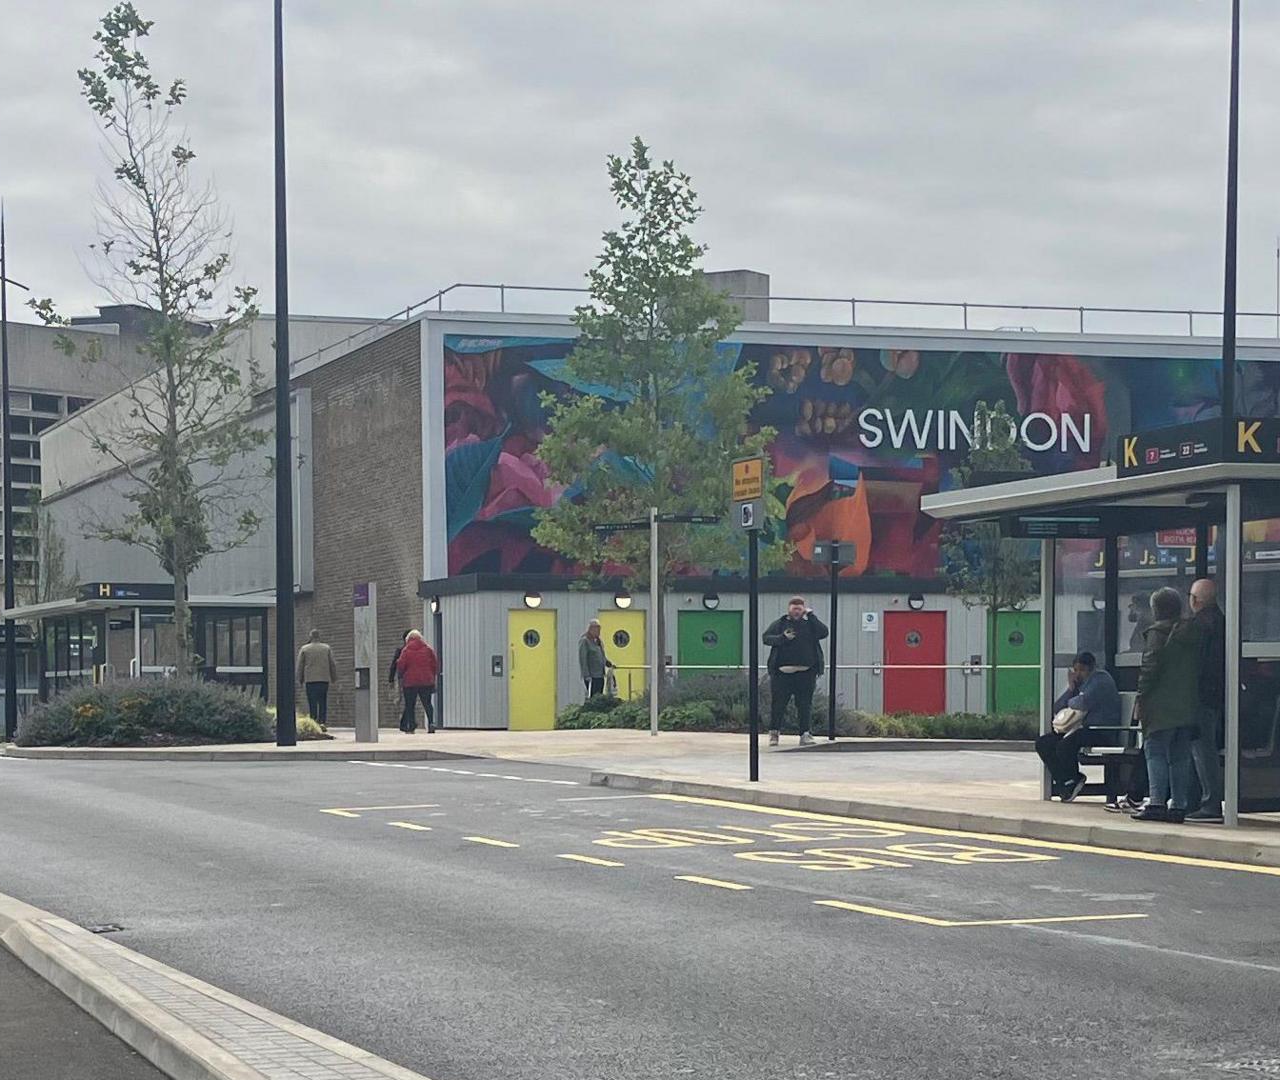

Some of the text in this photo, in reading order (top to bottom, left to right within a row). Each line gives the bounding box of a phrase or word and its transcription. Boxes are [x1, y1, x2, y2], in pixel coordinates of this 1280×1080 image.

[858, 407, 1091, 453] SWINDON
[1236, 421, 1263, 453] K
[1123, 436, 1139, 468] K
[99, 583, 111, 597] H
[734, 843, 1062, 871] BUS
